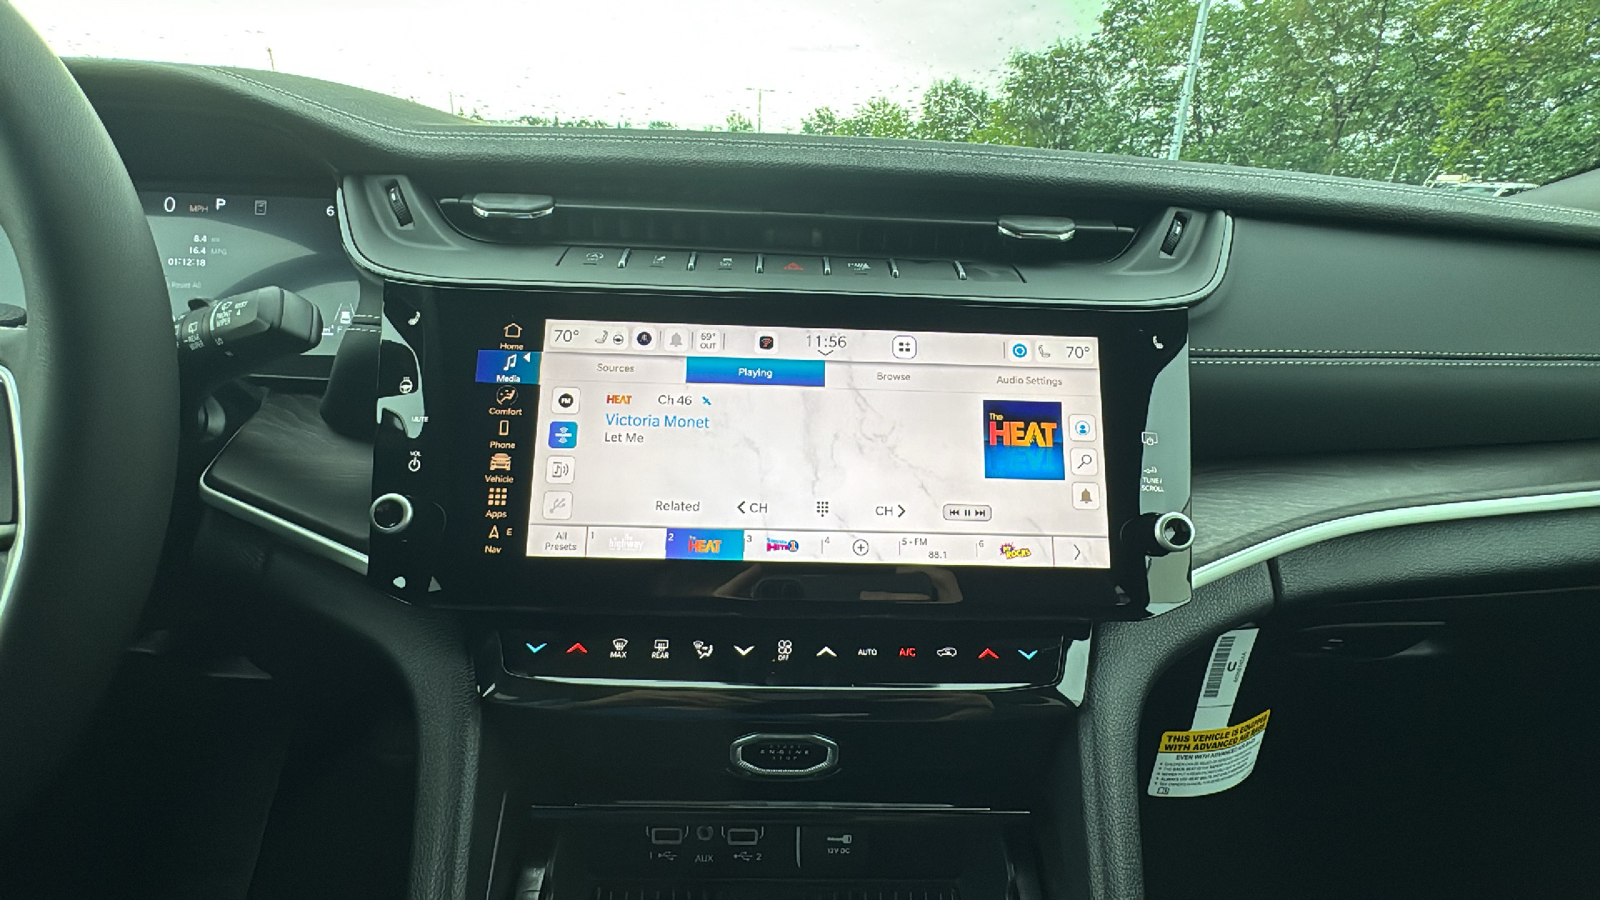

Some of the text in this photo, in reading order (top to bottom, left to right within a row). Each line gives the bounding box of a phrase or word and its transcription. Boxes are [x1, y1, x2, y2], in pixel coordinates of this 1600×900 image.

[164, 197, 209, 213] 0 MPH
[215, 198, 226, 211] P
[193, 234, 207, 243] 8.4
[189, 246, 206, 255] 16.4
[168, 257, 206, 267] 01:12:18
[554, 329, 580, 343] 70°
[805, 334, 847, 348] 11:56
[499, 342, 524, 351] Home
[699, 342, 717, 350] OUT
[1065, 345, 1091, 358] 70°
[596, 363, 635, 373] Sources
[738, 368, 773, 379] Playing
[876, 372, 911, 382] Browse
[496, 374, 521, 383] Media
[996, 375, 1063, 387] Audio Settings
[606, 394, 632, 405] HEAT
[657, 395, 693, 406] Ch 46
[488, 407, 522, 416] Comfort
[605, 412, 710, 429] Victoria Monet
[988, 412, 1004, 421] The
[604, 432, 644, 444] Let Me
[988, 420, 1057, 447] HEAT
[489, 441, 516, 450] Phone
[485, 475, 514, 484] Vehicle
[1141, 484, 1164, 492] SCROLL
[655, 500, 700, 512] Related
[749, 503, 768, 514] CH
[485, 510, 508, 520] Apps
[875, 506, 893, 517] CH
[506, 528, 513, 536] E
[555, 531, 568, 540] All
[668, 533, 674, 541] 2
[824, 536, 830, 544] 4
[544, 542, 577, 551] Presets
[608, 537, 644, 552] highway
[688, 538, 723, 553] HEAT
[979, 540, 984, 548] 6
[484, 545, 503, 554] Nav
[928, 551, 947, 559] 88.1
[610, 651, 628, 659] MAX
[651, 651, 670, 660] REAR
[857, 648, 878, 656] AUTO
[898, 647, 917, 657] A/C
[778, 654, 790, 662] OFF
[1166, 714, 1268, 743] THIS VEHICLE IS EQUIPPED
[1164, 743, 1191, 751] WITH
[1193, 737, 1239, 751] ADVANCED
[694, 854, 714, 863] AUX
[756, 852, 762, 861] 2
